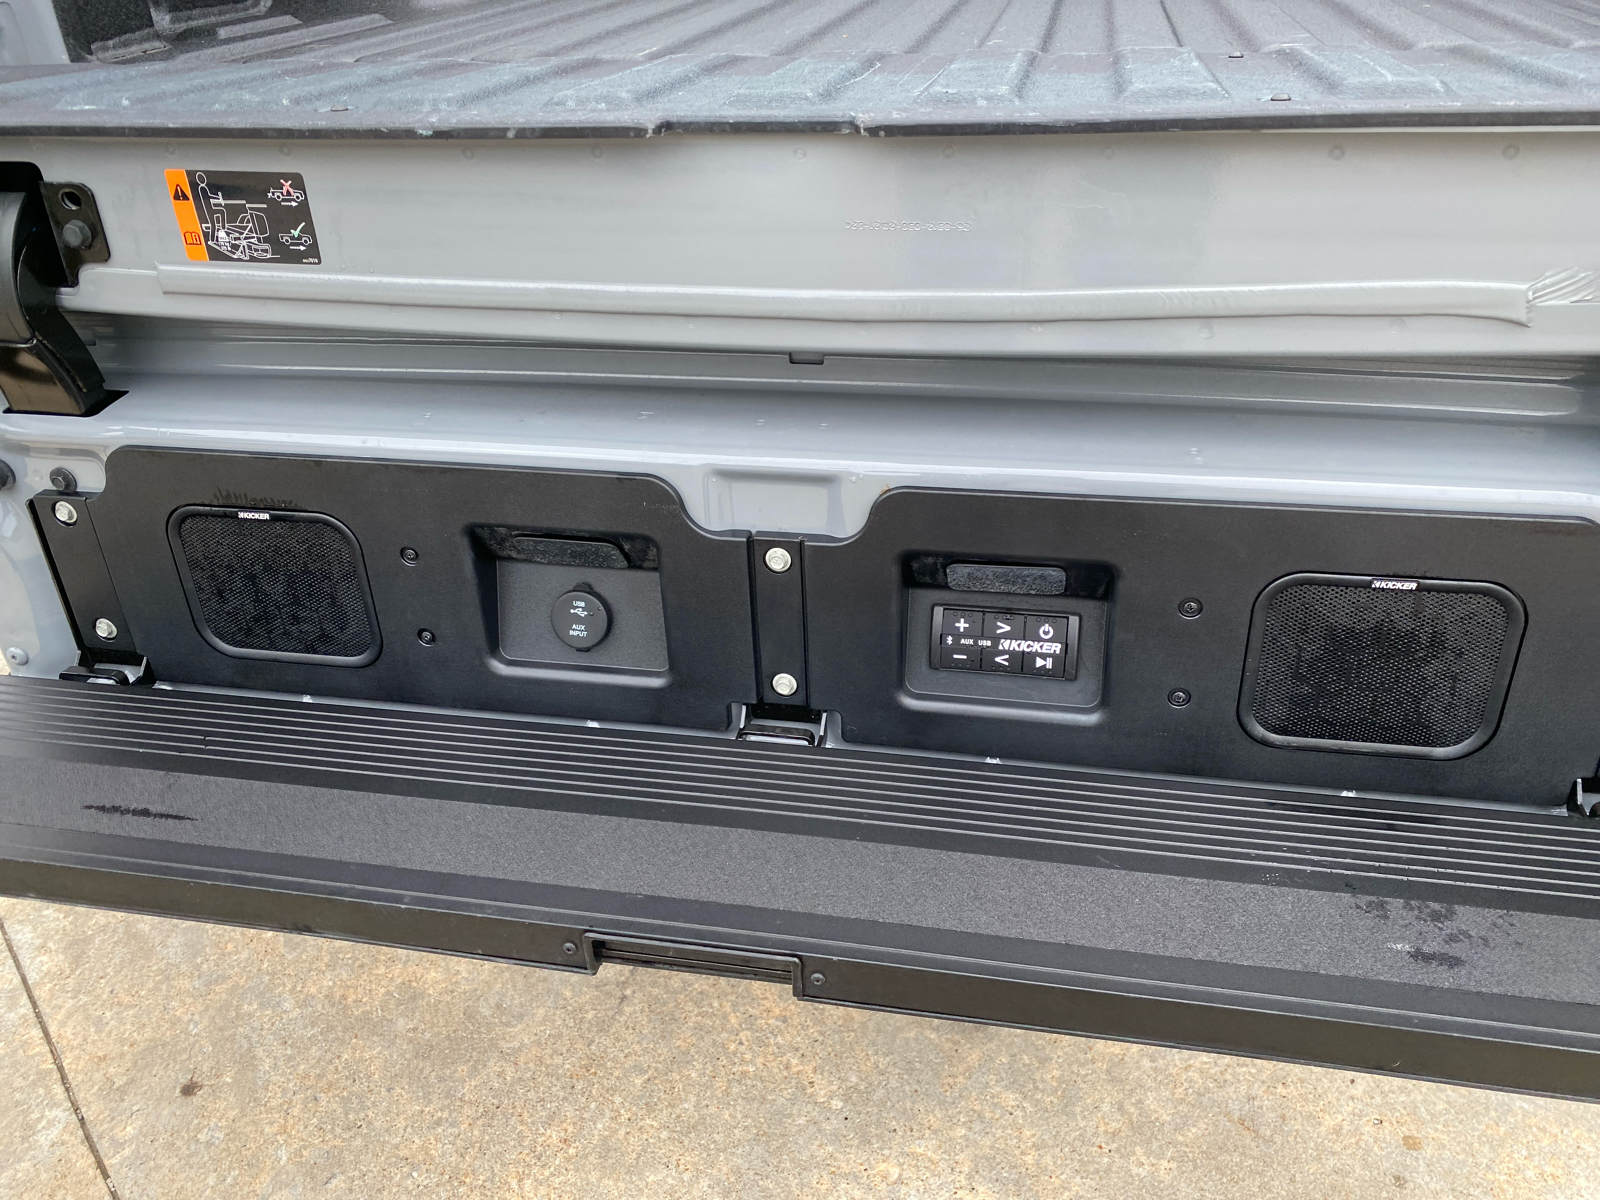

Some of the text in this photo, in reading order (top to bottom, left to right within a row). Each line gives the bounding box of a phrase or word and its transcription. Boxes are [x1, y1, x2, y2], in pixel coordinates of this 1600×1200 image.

[244, 512, 270, 520] KICKER
[1380, 581, 1418, 591] KICKER
[572, 600, 586, 608] USB
[571, 623, 586, 631] AUX
[569, 629, 588, 638] INPUT
[960, 638, 992, 647] AUX USB
[1009, 639, 1062, 655] KICKER
